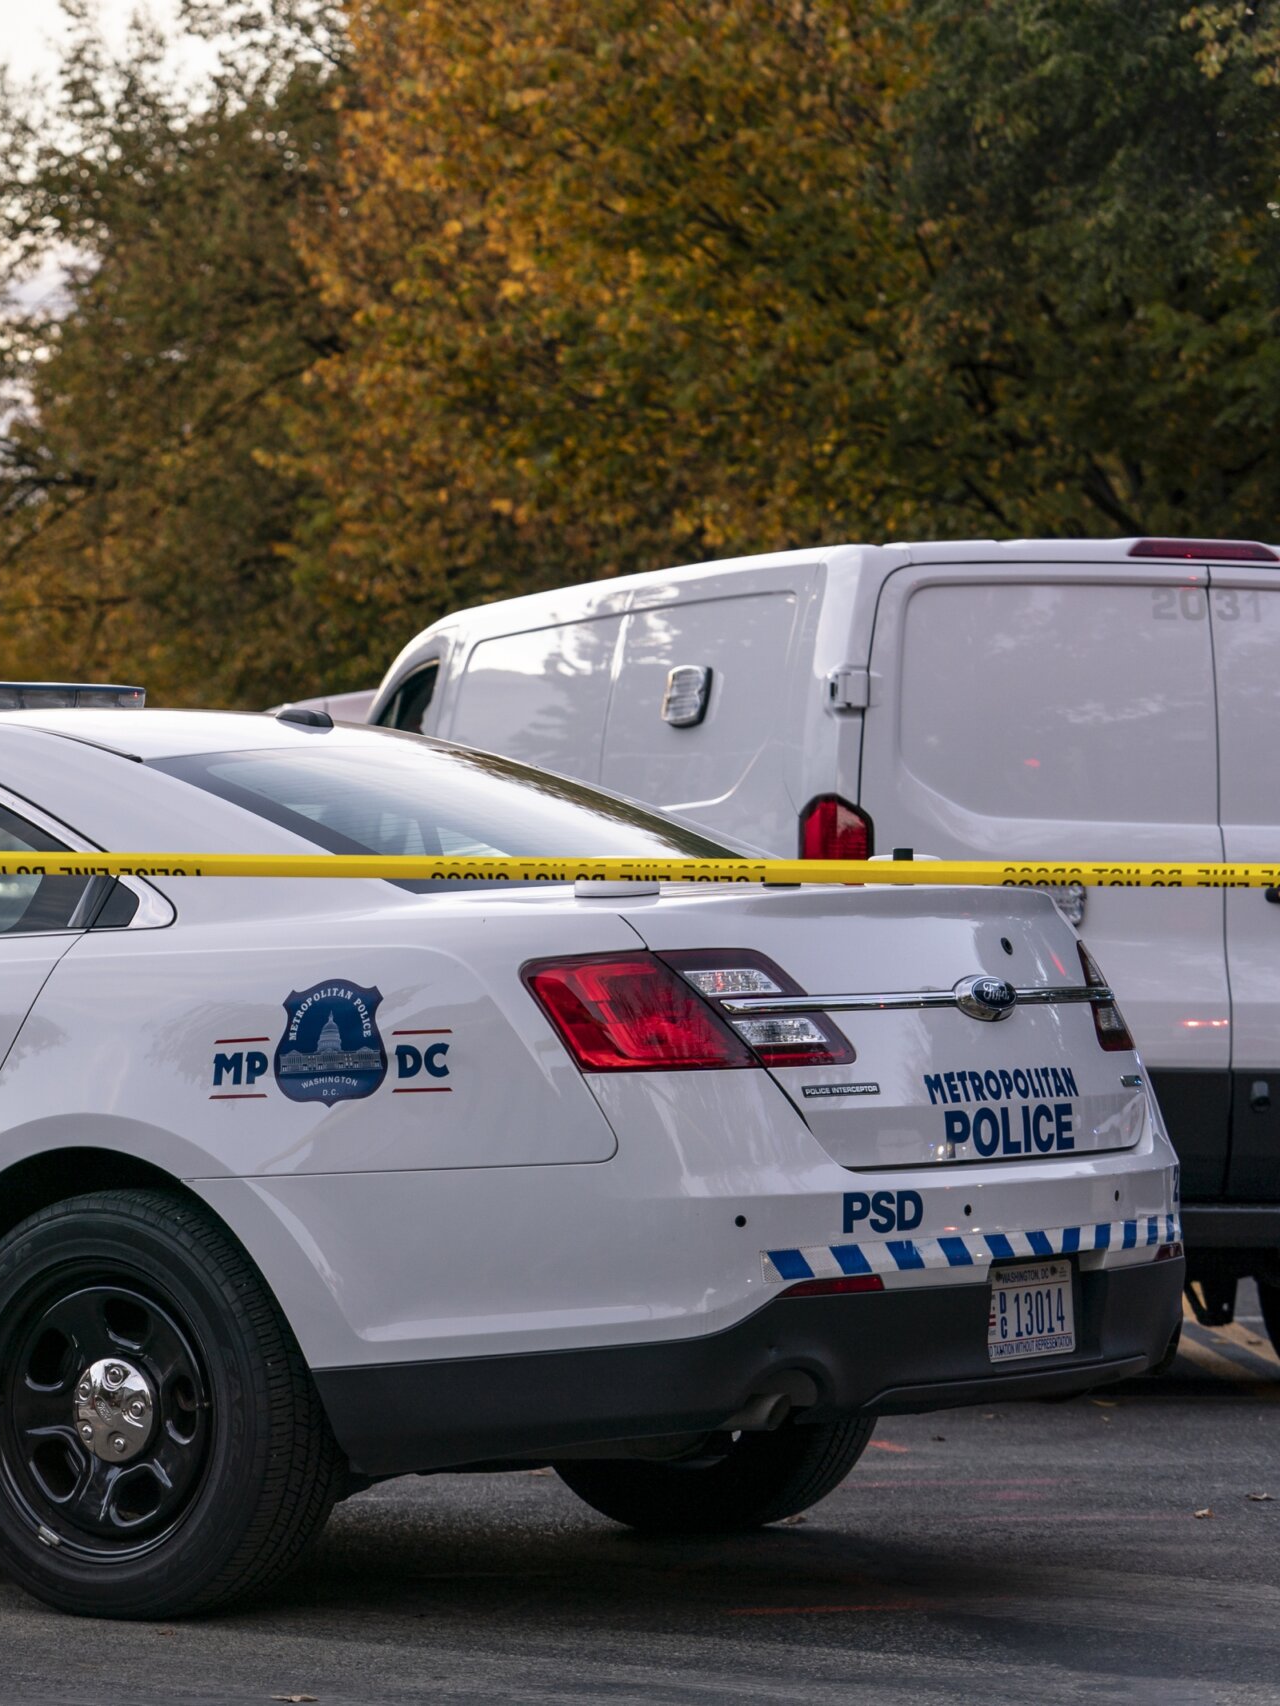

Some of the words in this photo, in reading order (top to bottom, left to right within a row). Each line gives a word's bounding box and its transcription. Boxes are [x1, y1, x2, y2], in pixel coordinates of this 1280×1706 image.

[983, 982, 1010, 1000] Ford
[289, 987, 353, 1041] METROPOLITAN
[353, 998, 372, 1038] POLICE
[213, 1051, 269, 1086] MP
[394, 1042, 450, 1079] DC
[301, 1076, 358, 1089] WASHINGTON
[322, 1088, 340, 1096] D.C.
[804, 1087, 830, 1095] POLICE
[831, 1085, 878, 1094] INTERCEPTOR
[923, 1066, 1080, 1105] METROPOLITAN
[944, 1103, 1075, 1159] POLICE
[843, 1190, 924, 1234] PSD
[1014, 1287, 1065, 1338] 13014
